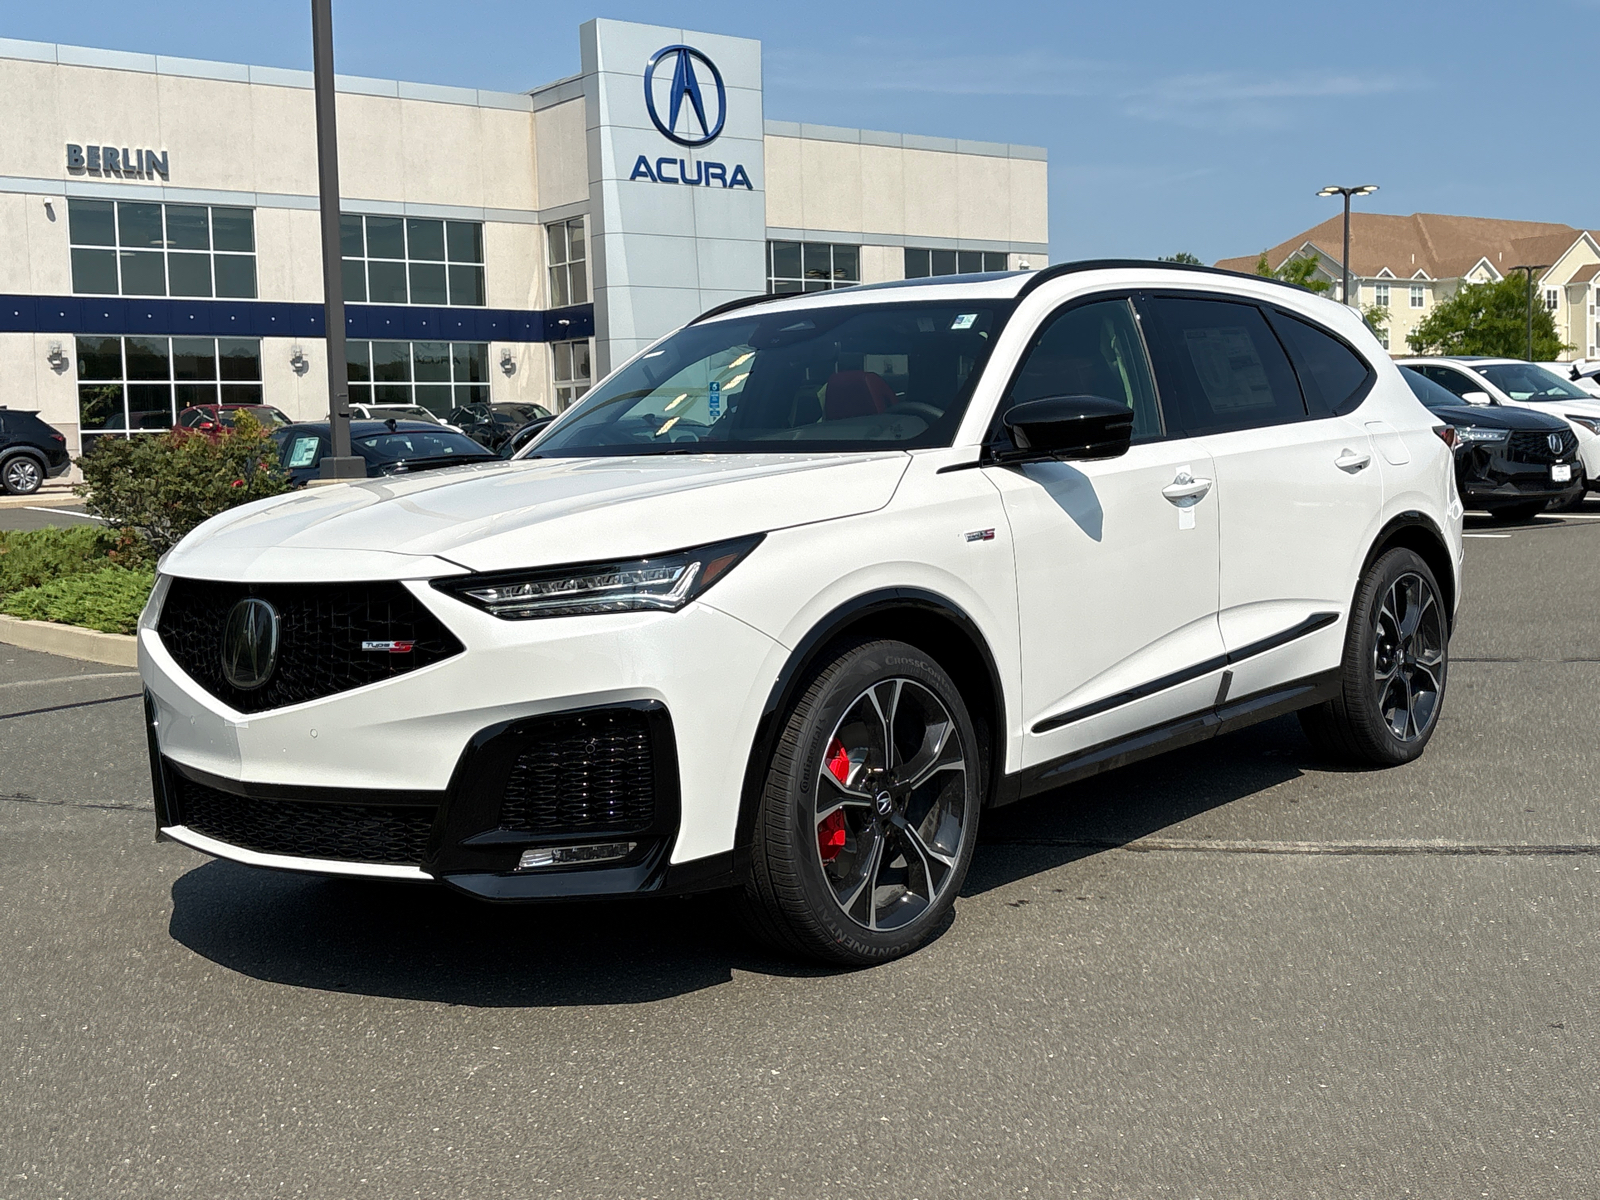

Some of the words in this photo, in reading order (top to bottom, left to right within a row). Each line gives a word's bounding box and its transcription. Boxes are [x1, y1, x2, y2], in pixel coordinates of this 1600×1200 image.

[66, 143, 169, 177] BERLIN
[630, 155, 753, 190] ACURA
[389, 640, 415, 653] S
[800, 725, 823, 794] Continental
[817, 902, 911, 957] CONTINENTAL
